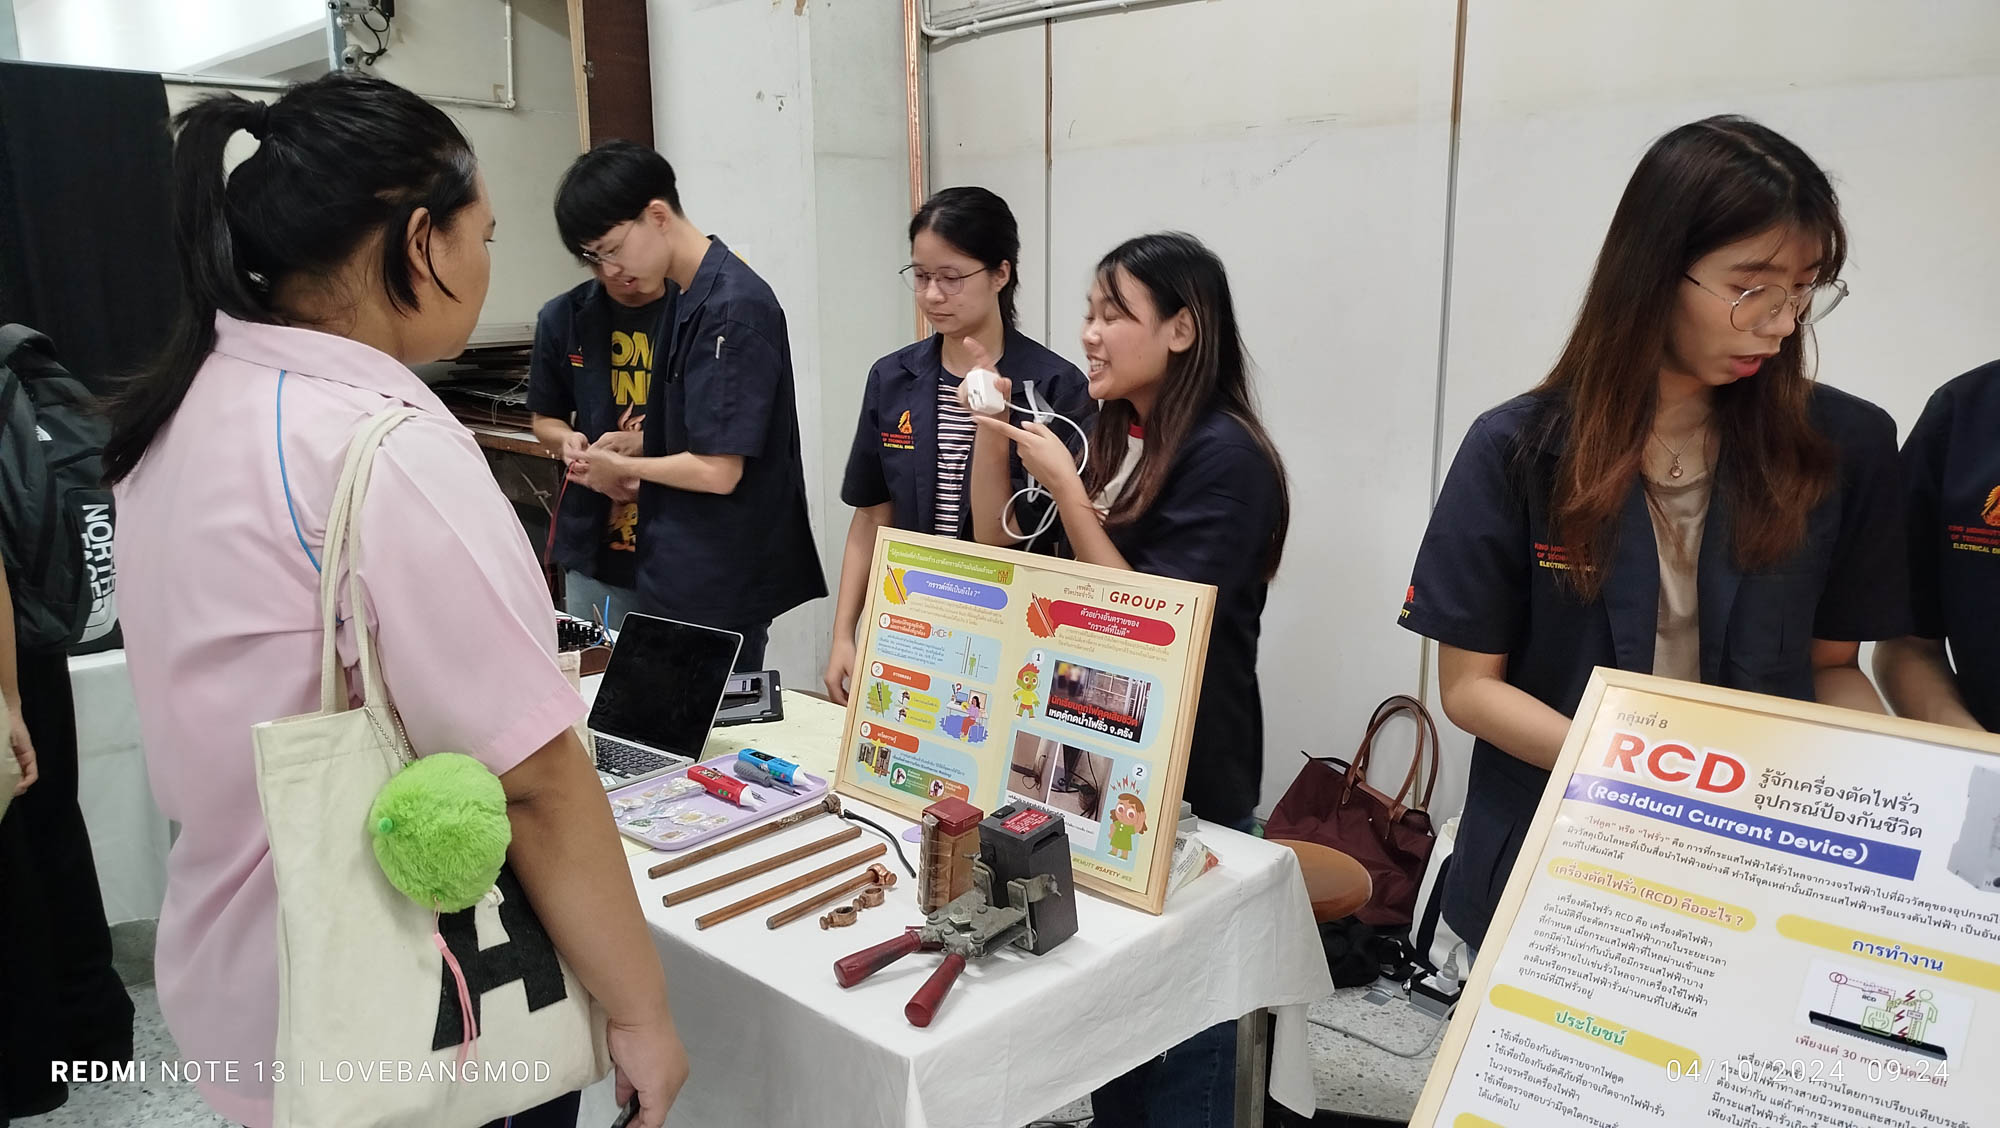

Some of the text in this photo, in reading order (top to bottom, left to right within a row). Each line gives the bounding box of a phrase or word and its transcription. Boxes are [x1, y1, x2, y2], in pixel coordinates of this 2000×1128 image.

[82, 504, 114, 593] NORTH
[1109, 591, 1184, 615] GROUP 7
[1036, 653, 1041, 661] 1
[1616, 710, 1668, 729] กลุ่มที่ 8
[1136, 767, 1143, 777] 2
[1602, 732, 1746, 794] RCD
[1758, 768, 1920, 816] รู้จักเครื่องตัดไฟรั่ว
[1587, 780, 1869, 865] (Residual Current Device)
[1753, 791, 1923, 839] อุปกรณ์ป้องกันชีวิต
[1555, 861, 1744, 927] เครื่องตัดไฟรั่ว (RCD) คืออะไร ?
[1671, 836, 1685, 849] คือ
[1686, 841, 2000, 925] การที่กระแสไฟฟ้าได้รั่วไหลจากวงจรไฟฟ้าไปที่ผิววัสดุของอุปกรณ์ไ
[1538, 914, 1572, 932] ที่กำหนด
[1557, 892, 1713, 948] เครื่องตัดไฟรั่ว RCD คือ เครื่องตัดไฟฟ้า
[1852, 938, 1944, 972] การทำงาน
[1518, 965, 1594, 1000] อุปกรณ์ที่มีไฟรั่วอยู่
[1554, 1009, 1627, 1046] ประโยชน์
[1500, 1028, 1624, 1084] ใช้เพื่อป้องกันอันตรายจากไฟดูด
[1795, 1035, 1839, 1055] เพียงแค่
[1842, 1049, 1857, 1061] 30
[1489, 1058, 1580, 1101] ในวงจรหรือเครื่องไฟฟ้า
[1716, 1076, 1767, 1102] ต้องเท่ากัน
